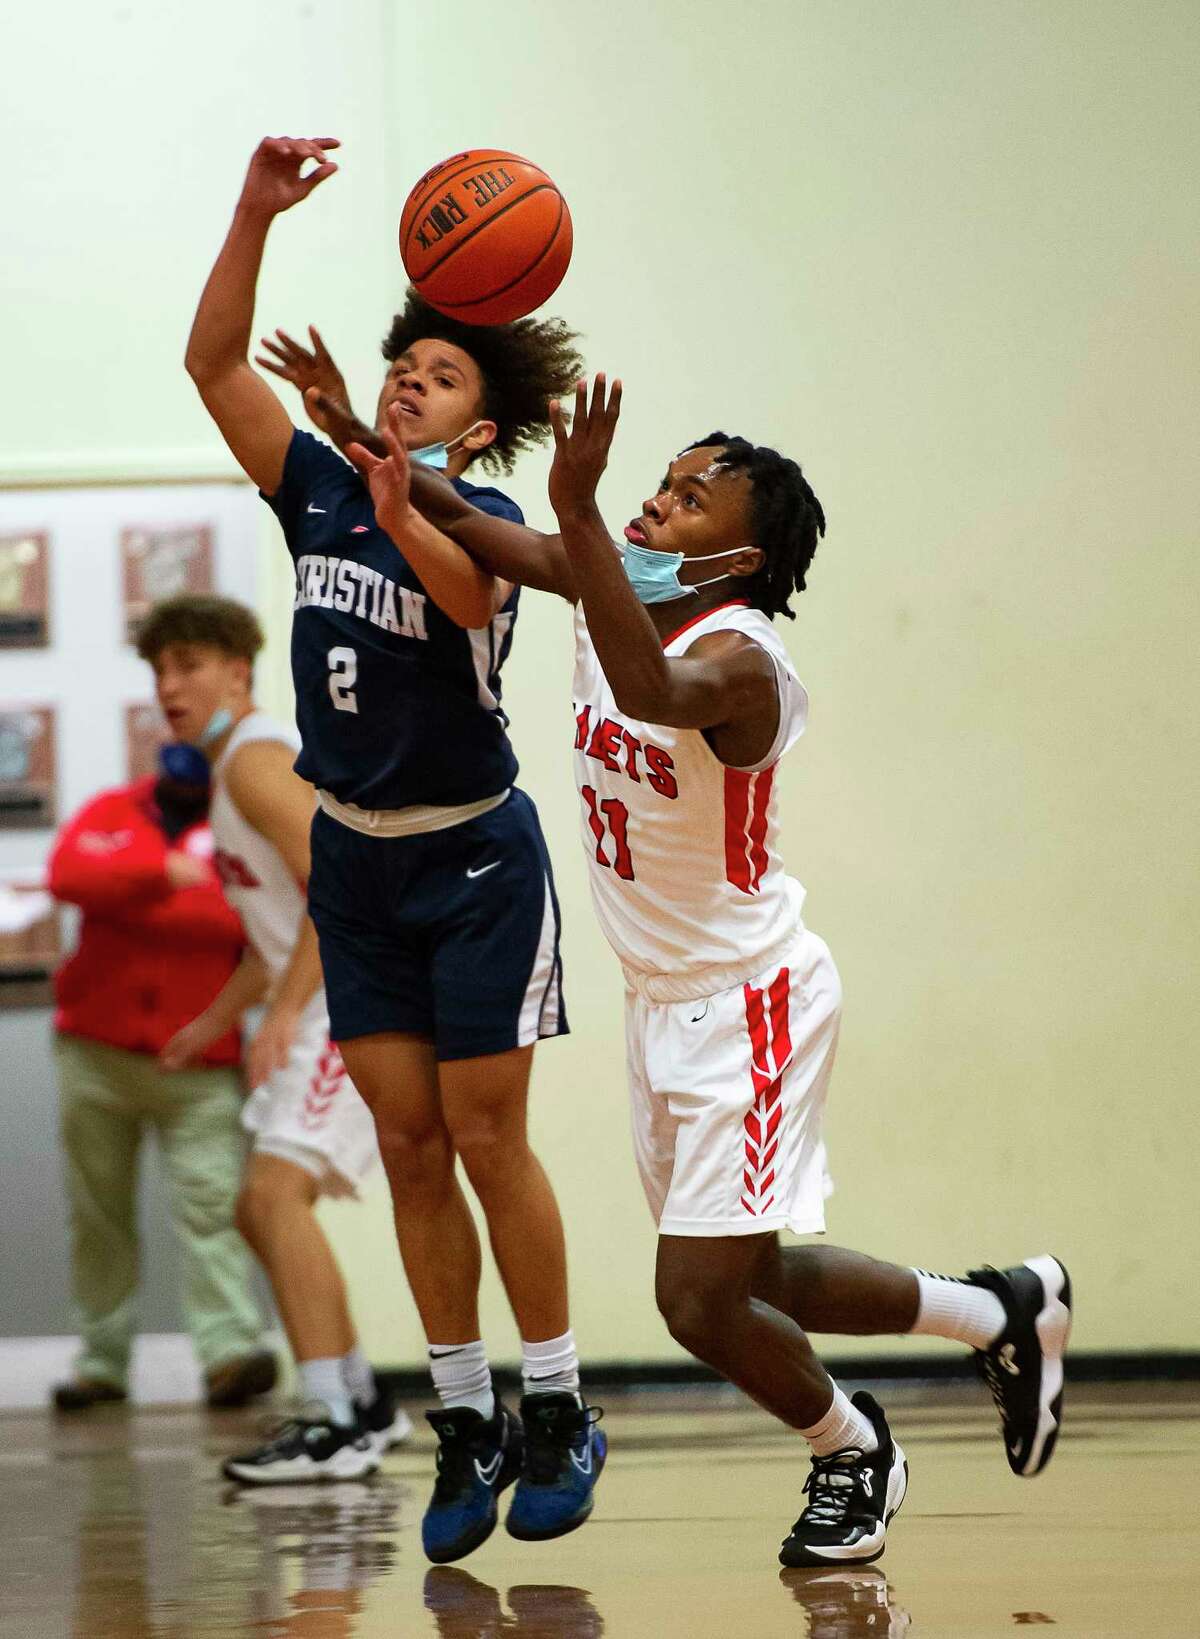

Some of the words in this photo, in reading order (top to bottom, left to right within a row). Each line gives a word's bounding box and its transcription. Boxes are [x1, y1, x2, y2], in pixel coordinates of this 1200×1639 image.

[464, 168, 516, 208] THE
[415, 193, 468, 250] ROCK
[327, 646, 359, 713] 2
[581, 785, 635, 882] 11
